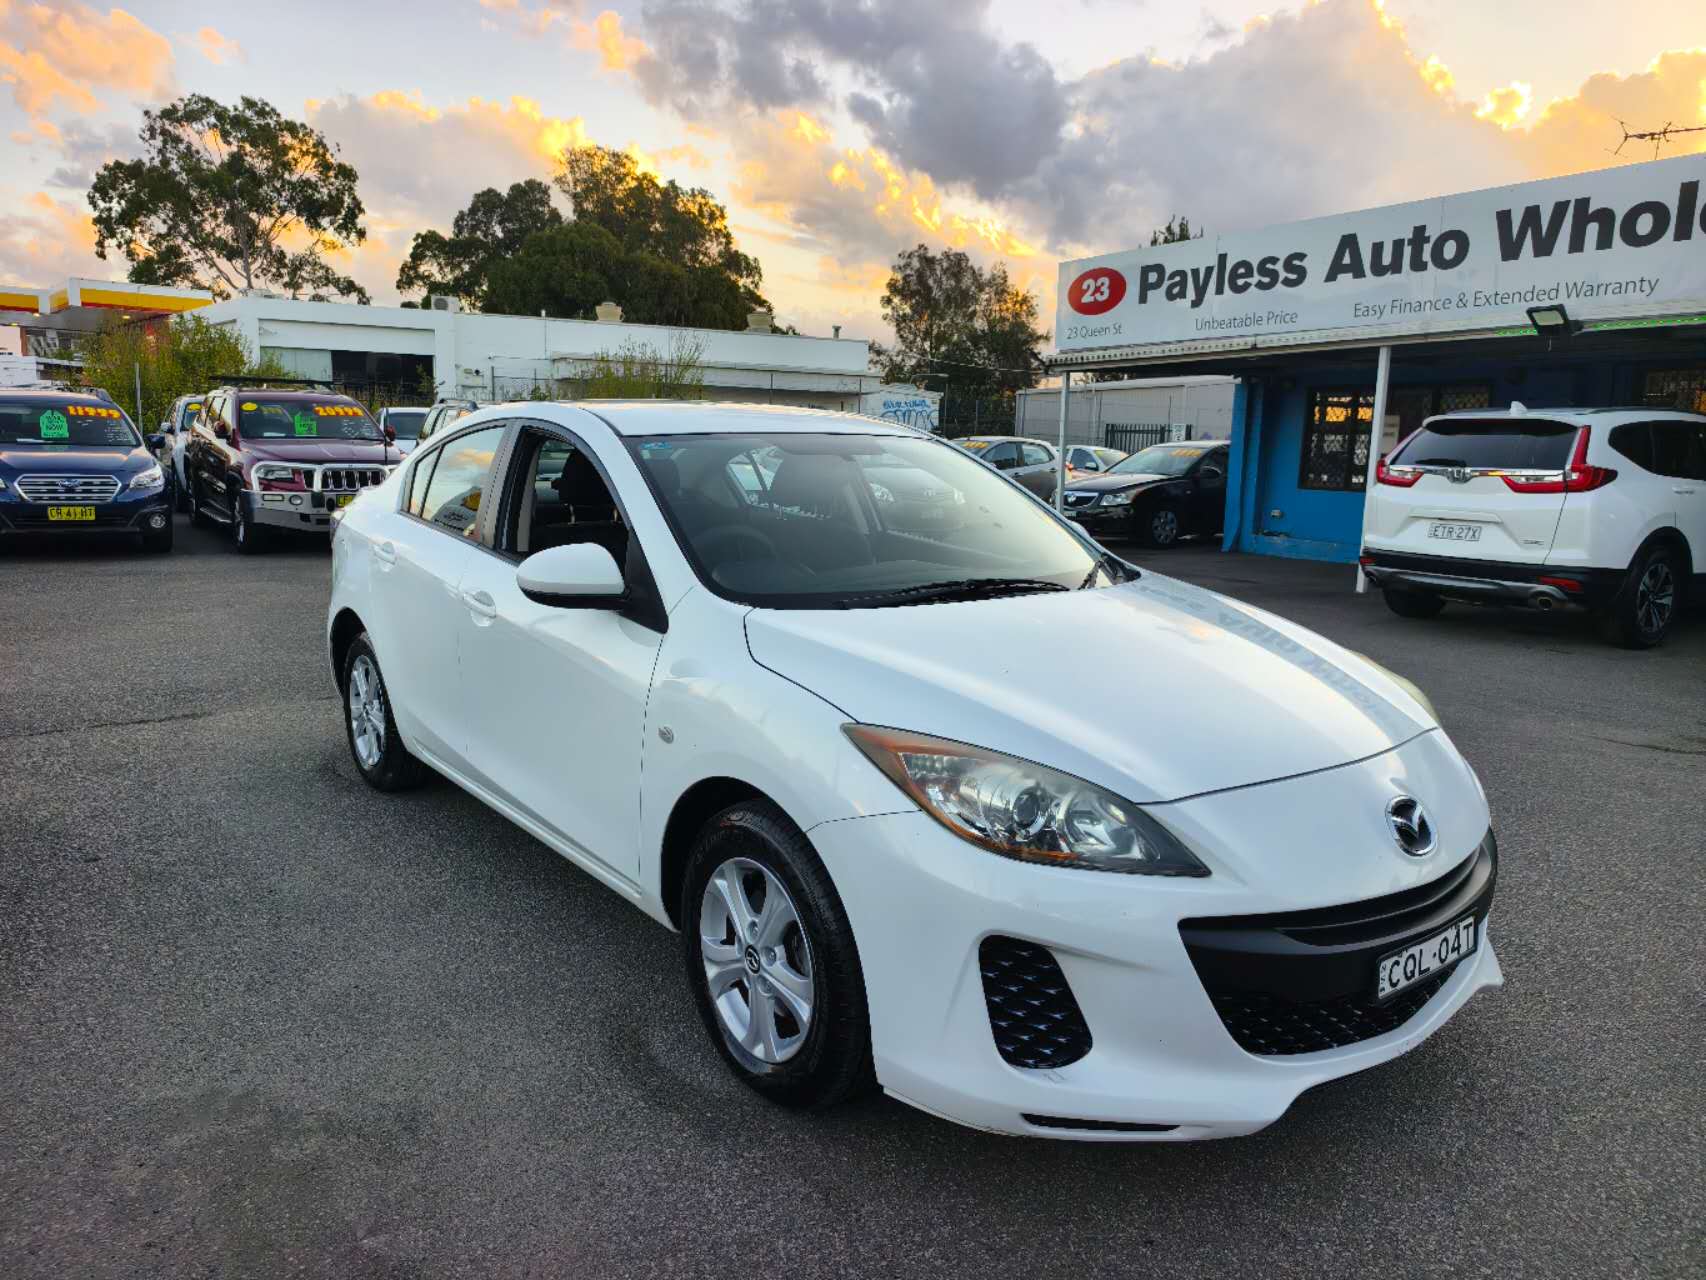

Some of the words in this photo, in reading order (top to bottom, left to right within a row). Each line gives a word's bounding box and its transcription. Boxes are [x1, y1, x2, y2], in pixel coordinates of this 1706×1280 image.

[1138, 252, 1308, 309] Payless
[1324, 224, 1470, 282] Auto
[1495, 180, 1706, 263] Whol
[1081, 277, 1110, 304] 23
[1354, 302, 1386, 319] Easy
[1390, 298, 1452, 315] Finance
[1455, 292, 1469, 309] &
[1473, 284, 1560, 307] Extended
[1565, 276, 1660, 299] Warranty
[1067, 326, 1079, 339] 23
[1080, 324, 1112, 338] Queen
[1113, 322, 1123, 334] St
[1195, 312, 1264, 331] Unbeatable
[1266, 309, 1299, 325] Price
